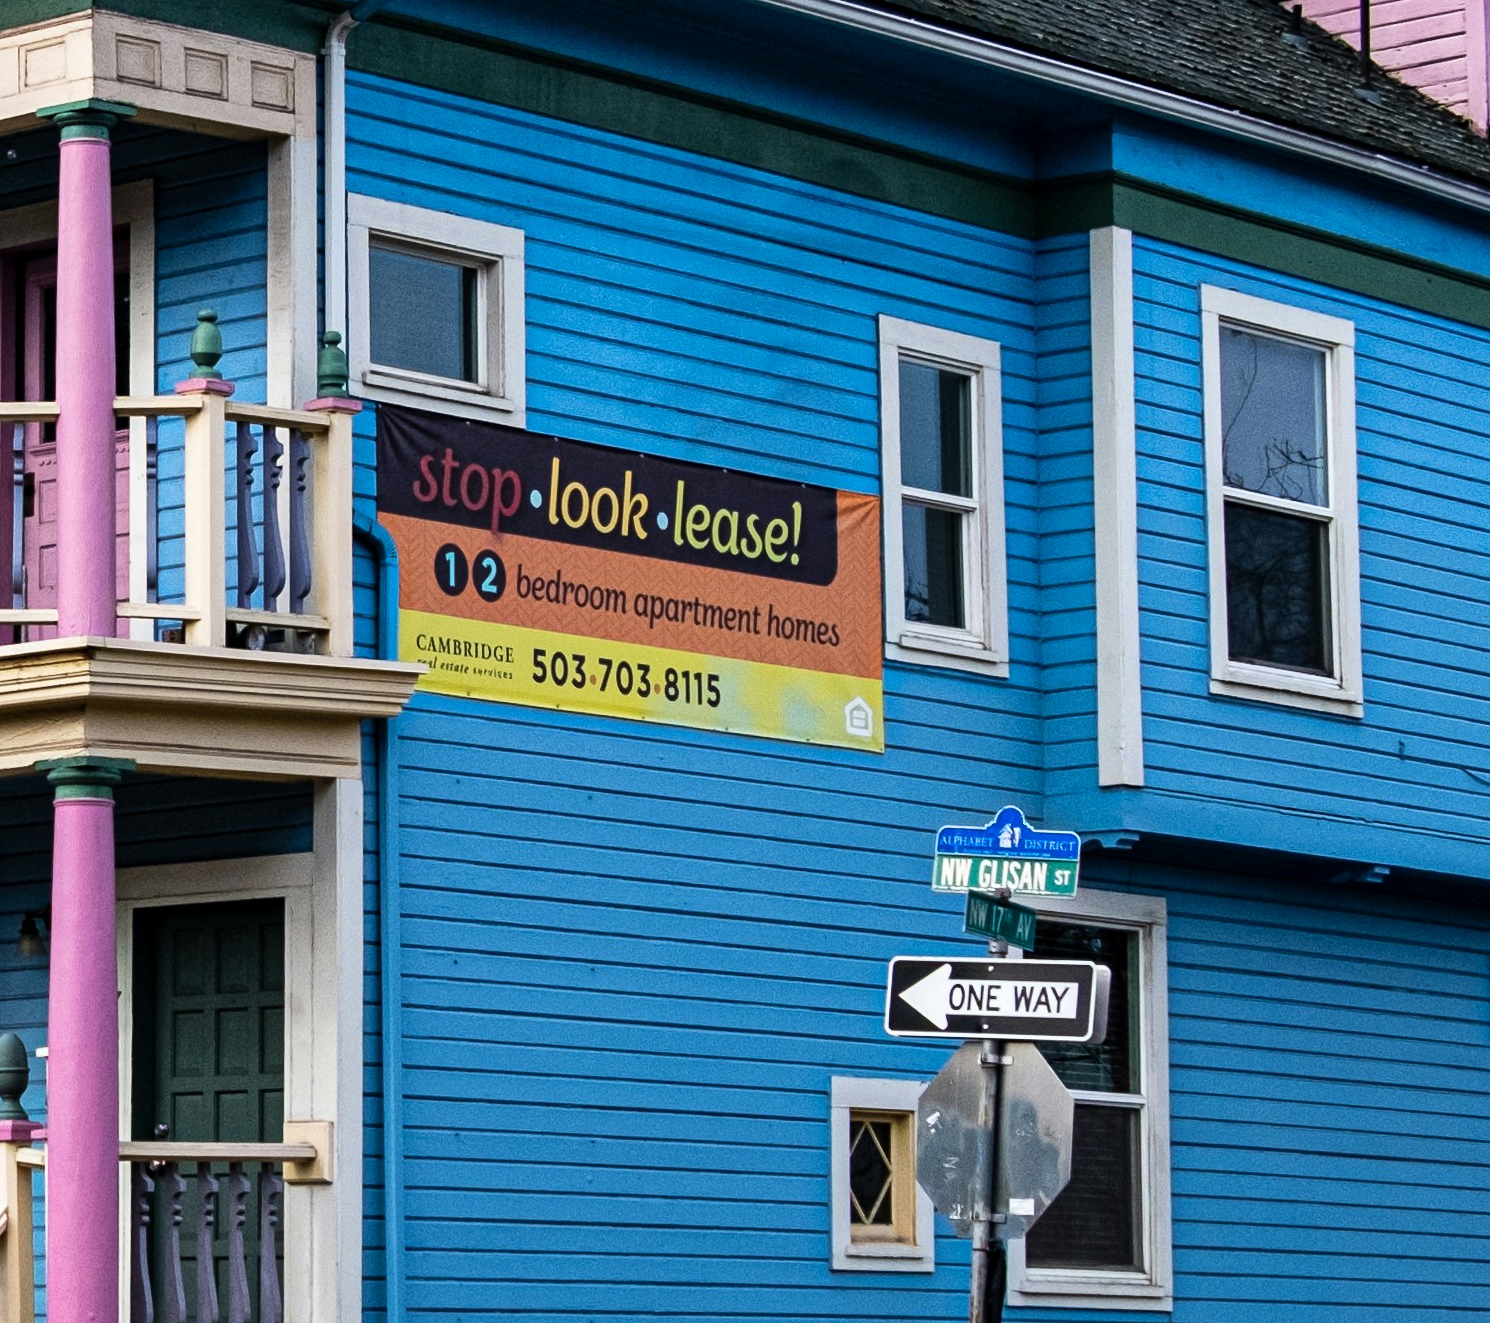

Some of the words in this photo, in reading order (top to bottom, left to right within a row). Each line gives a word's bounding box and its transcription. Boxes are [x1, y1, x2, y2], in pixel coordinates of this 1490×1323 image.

[413, 448, 521, 534] stop
[548, 456, 649, 540] look
[674, 480, 802, 566] lease!
[445, 551, 456, 587] 1
[481, 557, 498, 594] 2
[516, 563, 628, 614] bedroom
[634, 591, 761, 635] apartment
[767, 603, 840, 647] homes
[416, 633, 515, 664] CAMBRIDGE
[940, 835, 993, 848] ALPHABET
[1024, 839, 1076, 852] DISTRICT
[940, 857, 972, 887] NW
[978, 859, 1048, 891] GLISAN
[1054, 869, 1071, 886] ST
[968, 898, 988, 929] NW
[1015, 913, 1032, 942] AV
[949, 983, 1001, 1012] ONE
[1014, 985, 1070, 1014] WAY
